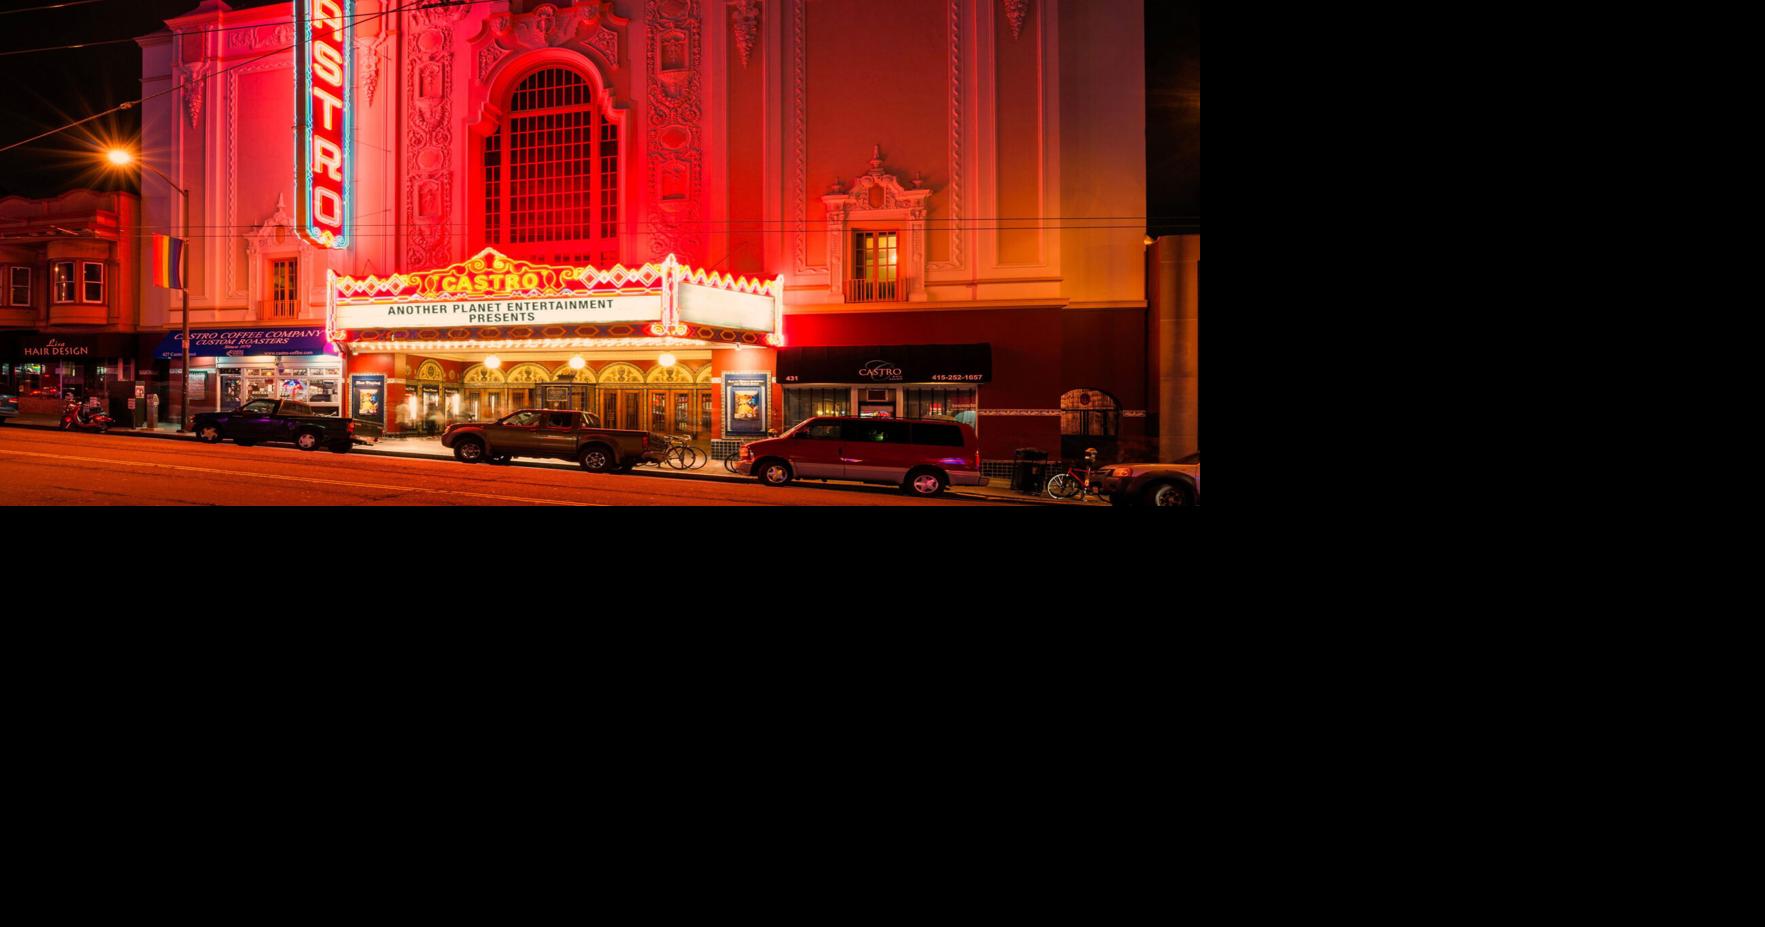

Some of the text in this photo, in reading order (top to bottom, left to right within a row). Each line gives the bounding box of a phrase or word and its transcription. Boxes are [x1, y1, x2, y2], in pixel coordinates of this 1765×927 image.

[441, 273, 539, 292] CASTRO
[387, 299, 614, 316] ANOTHER PLANET ENTERTAINMENT
[469, 312, 536, 323] PRESENTS
[174, 330, 323, 340] CSTRO COFFEE COMPANY
[196, 337, 290, 346] CUSTOM ROASTERS
[24, 346, 89, 356] HAIR DESIGN
[858, 368, 902, 376] CASTRO
